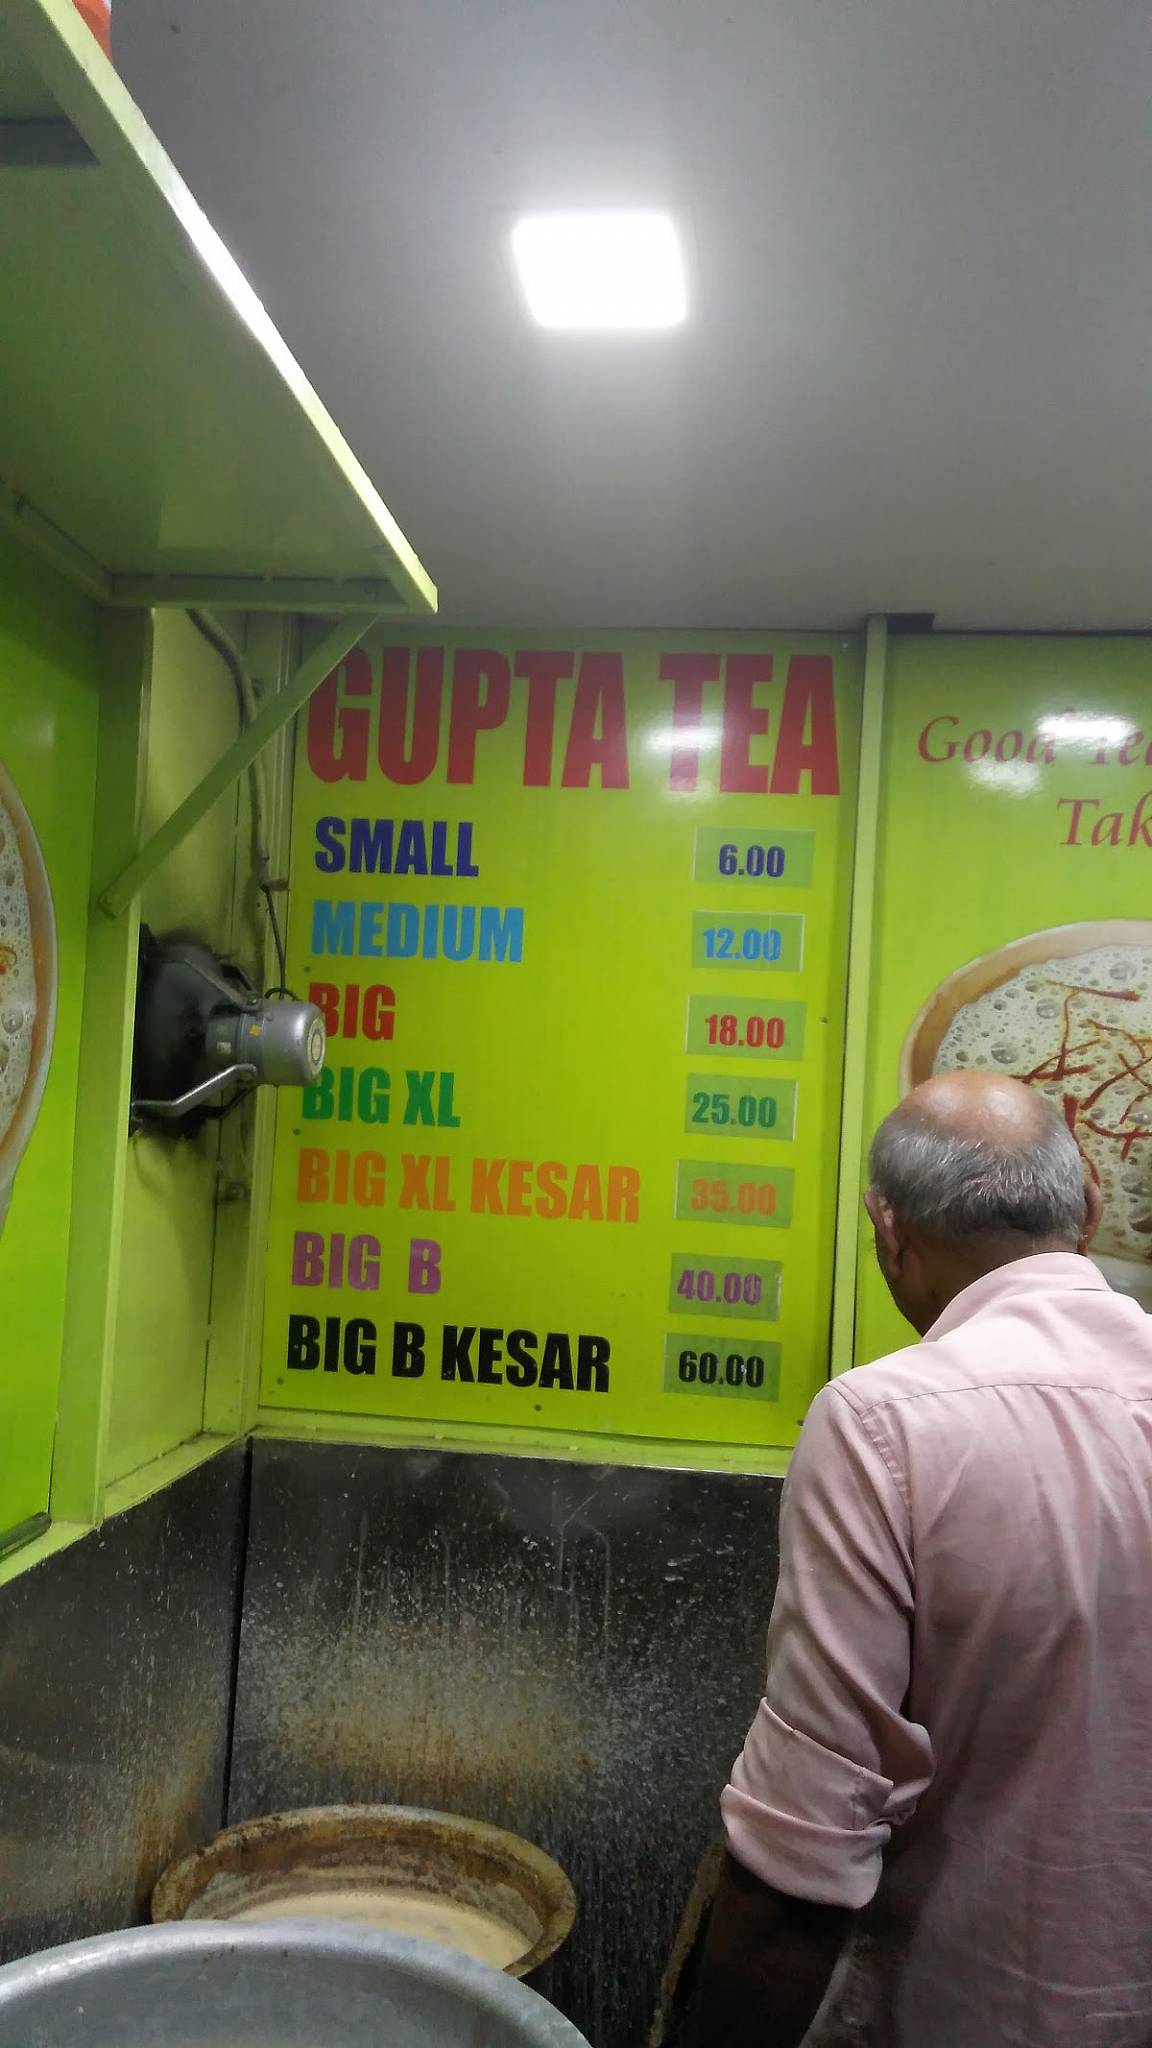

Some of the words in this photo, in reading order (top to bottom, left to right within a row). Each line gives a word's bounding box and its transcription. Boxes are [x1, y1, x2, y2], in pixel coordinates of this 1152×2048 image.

[306, 646, 629, 789] GUPTA
[659, 652, 840, 795] TEA
[314, 816, 479, 877] SMALL
[719, 844, 785, 878] 6.00
[312, 900, 524, 963] MEDIUM
[703, 927, 781, 961] 12.00
[308, 982, 396, 1041] BIG
[705, 1014, 785, 1049] 18.00
[302, 1066, 393, 1124] BIG
[404, 1071, 461, 1128] XL
[692, 1092, 777, 1128] 25.00
[297, 1147, 385, 1208] BIG
[398, 1154, 455, 1211] XL
[470, 1158, 640, 1223] KESAR
[691, 1179, 776, 1216] 35.00
[291, 1231, 381, 1291] BIG
[408, 1238, 442, 1295] B
[677, 1269, 762, 1305] 40.00
[287, 1314, 377, 1375] BIG
[392, 1322, 425, 1379] B
[441, 1325, 611, 1393] KESAR
[678, 1351, 764, 1388] 60.00
